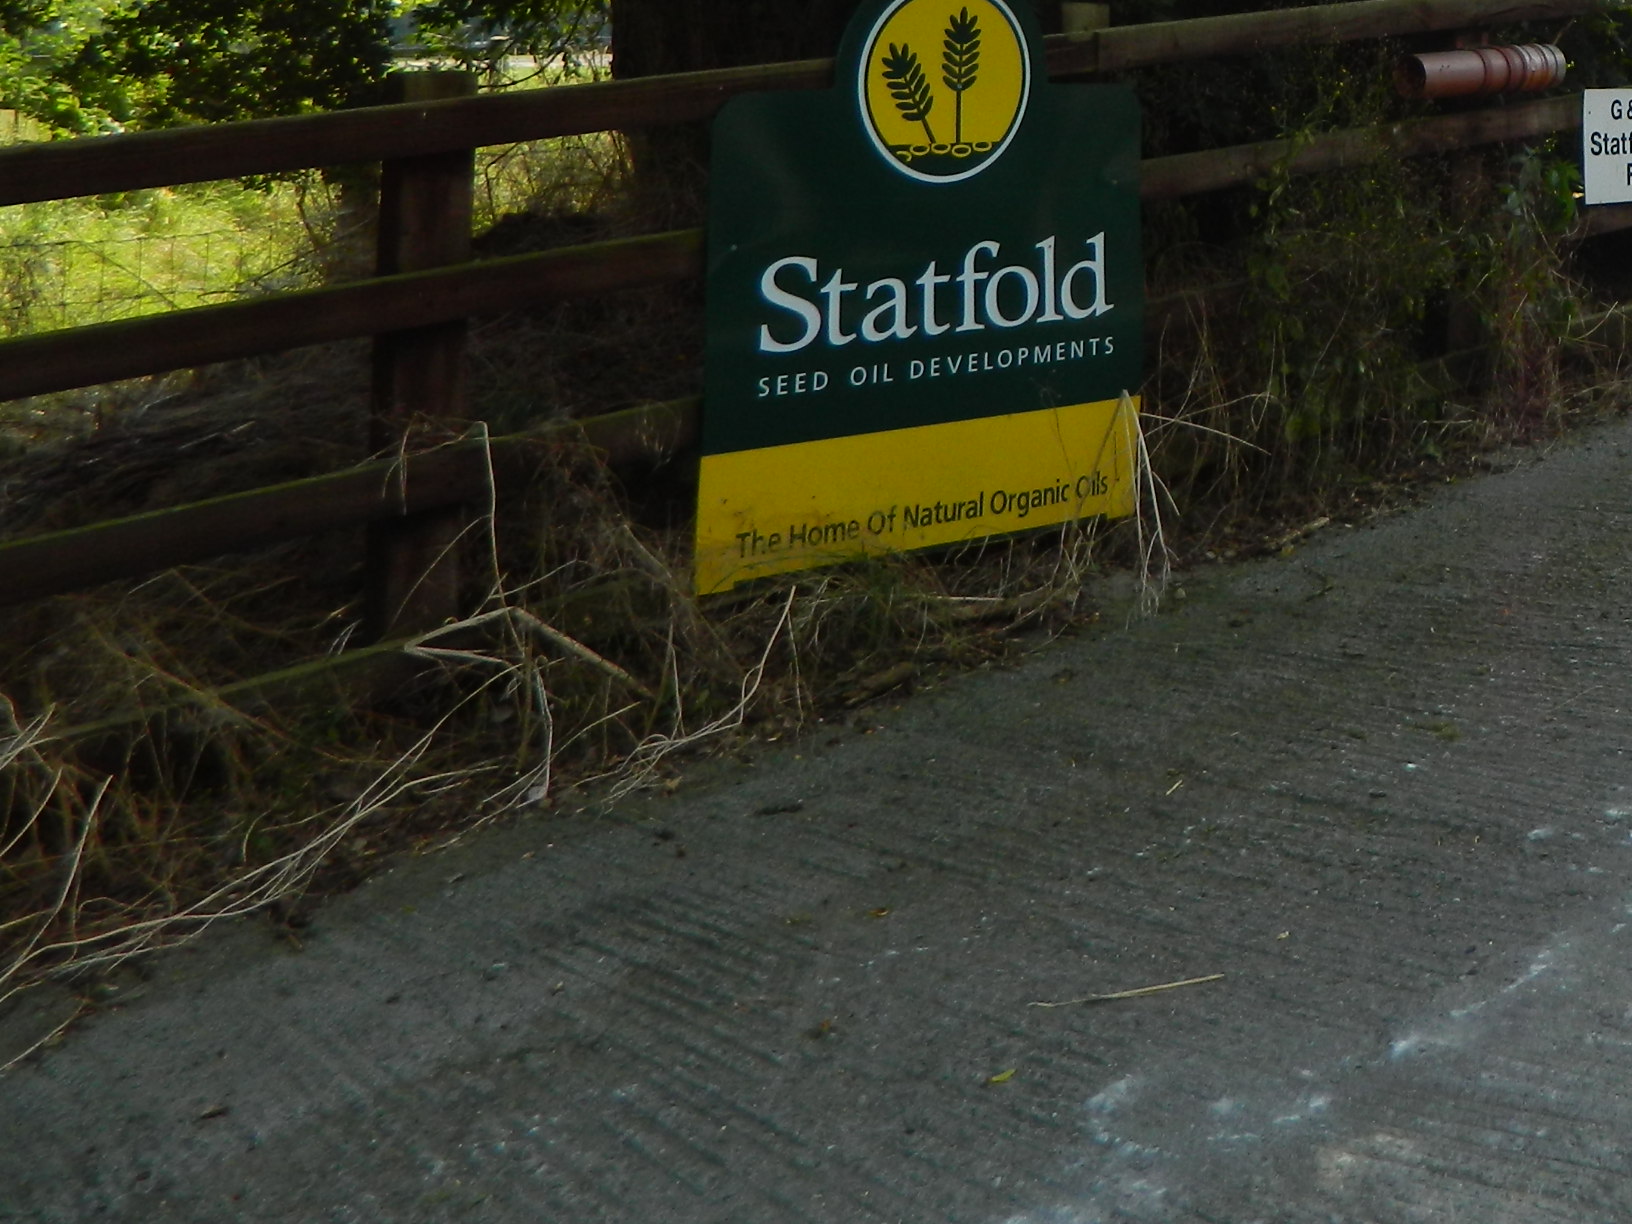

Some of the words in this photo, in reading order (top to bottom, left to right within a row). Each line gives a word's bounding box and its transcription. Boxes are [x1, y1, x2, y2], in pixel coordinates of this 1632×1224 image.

[1611, 99, 1622, 120] G
[758, 231, 1114, 353] Statfold
[757, 370, 830, 398] SEED
[850, 361, 894, 385] OIL
[909, 336, 1115, 380] DEVELOPMENTS
[735, 530, 782, 559] The
[788, 519, 859, 550] Home
[867, 506, 897, 535] Of
[903, 491, 985, 528] Natural
[989, 482, 1070, 519] Organic
[1075, 473, 1109, 501] Oils
